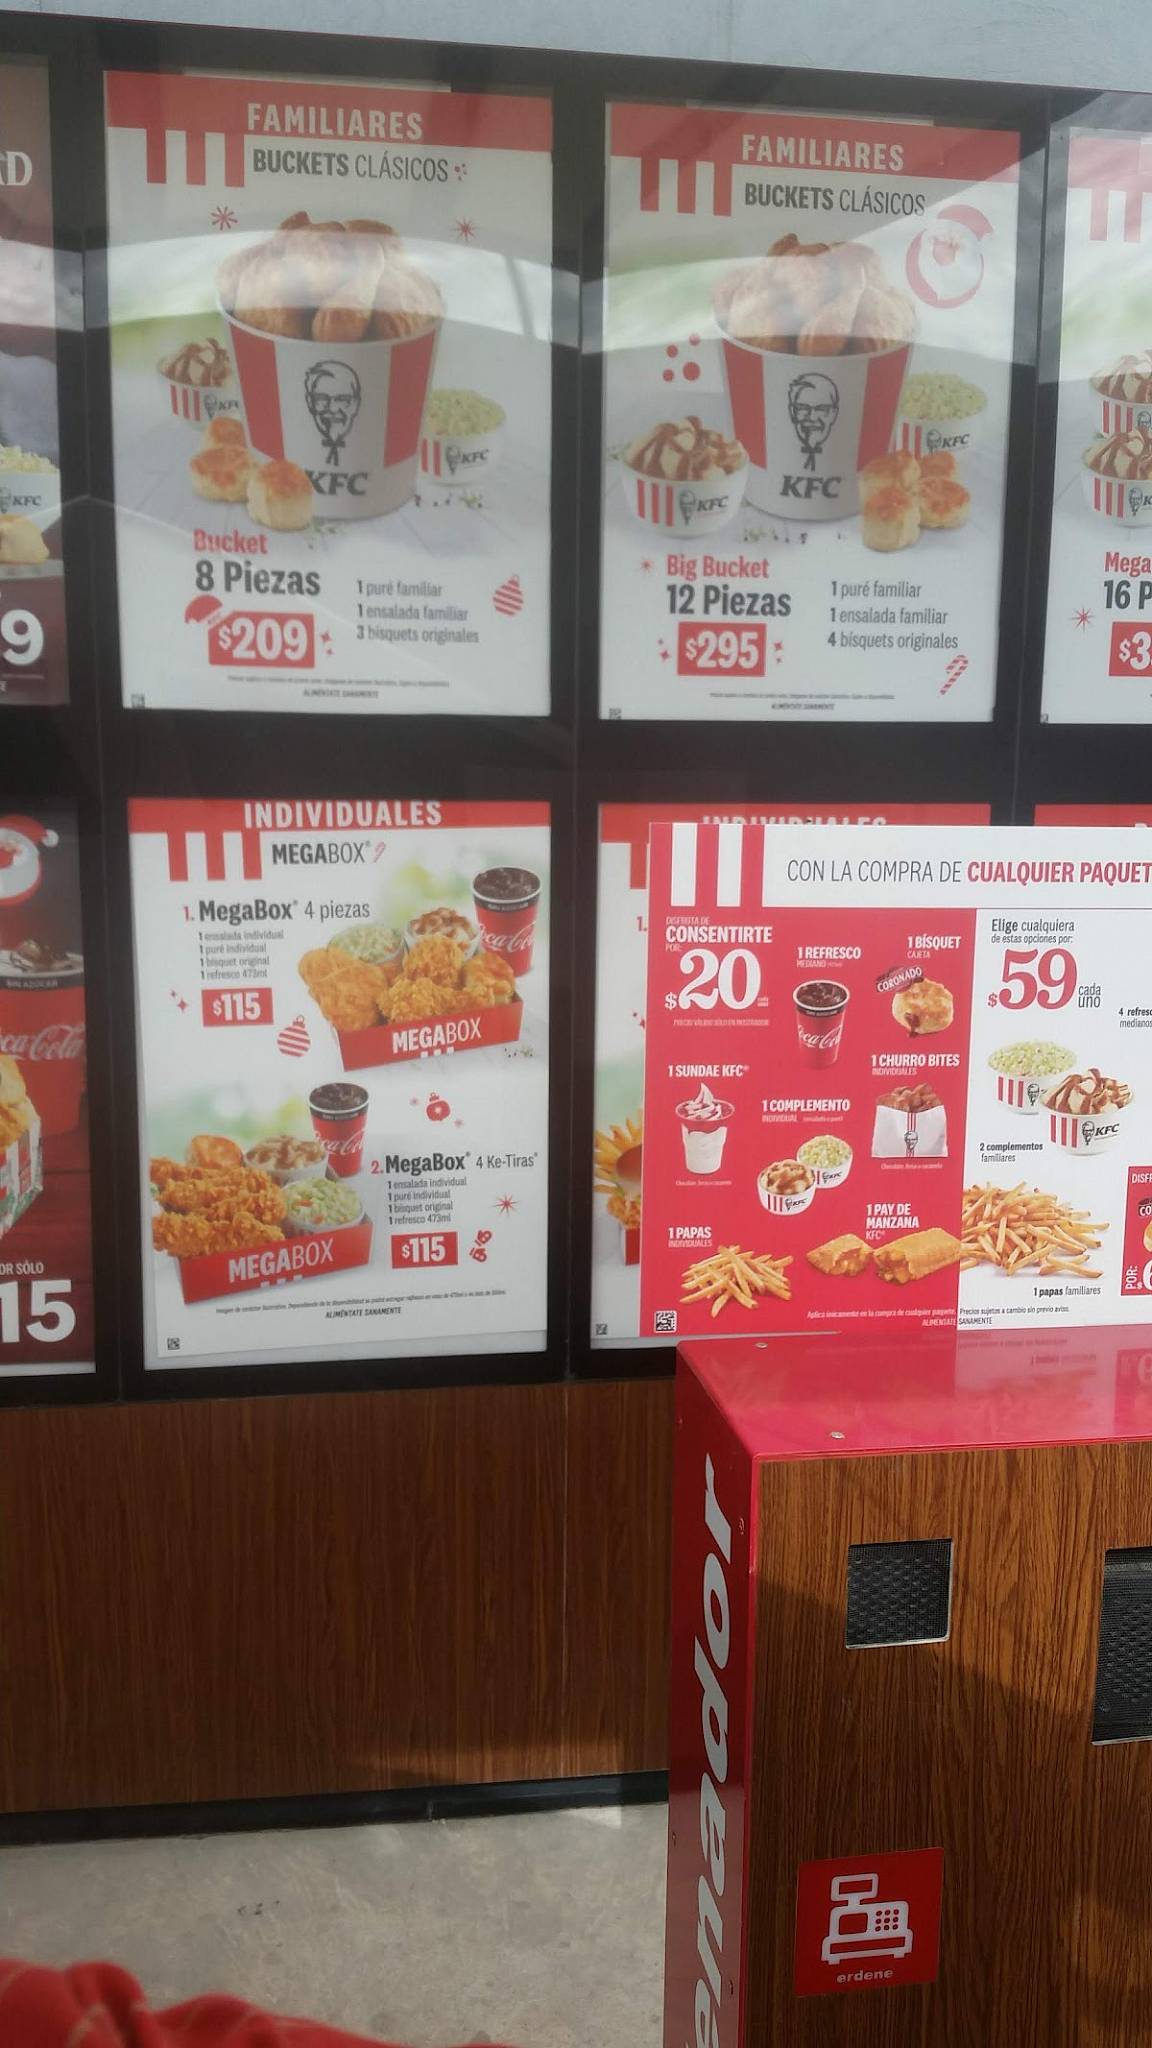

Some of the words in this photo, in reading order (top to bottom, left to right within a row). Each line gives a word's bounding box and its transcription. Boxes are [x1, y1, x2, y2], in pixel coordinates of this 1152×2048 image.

[247, 102, 423, 140] FAMILIARES
[742, 133, 905, 172] FAMILIARES
[252, 148, 350, 177] BUCKETS
[354, 150, 449, 182] CLÁSICOS
[744, 182, 835, 211] BUCKETS
[839, 185, 926, 217] CLÁSICOS
[942, 433, 970, 449] KFC
[461, 449, 489, 464] KFC
[305, 469, 368, 496] KFC
[780, 475, 842, 499] KFC
[13, 495, 41, 506] KFC
[697, 495, 729, 512] KFC
[193, 529, 268, 554] Bucket
[667, 554, 698, 582] Big
[703, 554, 770, 579] Bucket
[1104, 552, 1152, 577] Mega
[195, 560, 214, 592] 8
[224, 560, 321, 597] Piezas
[357, 579, 363, 594] 1
[396, 580, 442, 597] familiar
[831, 581, 838, 597] 1
[840, 580, 869, 600] puré
[872, 581, 921, 599] familiar
[1104, 580, 1131, 609] 16
[667, 584, 694, 614] 12
[704, 584, 791, 618] Piezas
[357, 602, 363, 618] 1
[366, 603, 420, 620] ensalada
[423, 604, 468, 621] familiar
[830, 607, 836, 623] 1
[839, 607, 896, 624] ensalada
[899, 607, 947, 625] familiar
[219, 616, 308, 661] $209
[356, 625, 364, 640] 3
[422, 627, 479, 645] originales
[827, 632, 837, 648] 4
[896, 632, 958, 652] originales
[685, 629, 759, 669] $295
[1119, 631, 1152, 671] $3
[244, 801, 442, 829] INDIVIDUALES
[787, 859, 826, 883] CON
[831, 859, 852, 882] LA
[858, 860, 933, 883] COMPRA
[940, 860, 962, 883] DE
[967, 861, 1075, 887] CUALQUIER
[1080, 861, 1152, 887] PAQUET
[304, 903, 316, 919] 4
[320, 900, 370, 922] piezas
[244, 929, 284, 940] individual
[665, 926, 773, 943] CONSENTIRTE
[991, 918, 1019, 935] Elige
[1021, 919, 1075, 935] cualquiera
[907, 936, 913, 948] 1
[915, 933, 961, 950] BÍSQUET
[991, 934, 1001, 943] de
[1002, 935, 1022, 943] estas
[1023, 934, 1057, 944] opciones
[1058, 935, 1074, 944] por:
[226, 943, 267, 954] individual
[798, 946, 803, 959] 1
[805, 946, 862, 959] REFRESCO
[907, 950, 931, 959] CAJETA
[239, 956, 269, 968] original
[797, 960, 827, 968] MEDIANO
[664, 948, 761, 1010] $20
[877, 966, 922, 993] CORONADO
[988, 948, 1078, 1010] $59
[1078, 983, 1101, 996] cada
[213, 992, 261, 1022] $115
[1078, 996, 1101, 1008] uno
[1118, 1007, 1124, 1017] 4
[392, 1017, 482, 1055] MEGABOX
[871, 1055, 877, 1067] 1
[879, 1054, 926, 1067] CHURRO
[928, 1053, 960, 1067] BITES
[668, 1065, 673, 1077] 1
[675, 1064, 720, 1078] SUNDAE
[769, 1099, 850, 1113] COMPLEMENTO
[1095, 1123, 1120, 1137] KFC
[979, 1143, 985, 1152] 2
[986, 1142, 1044, 1152] complementos
[371, 1160, 384, 1175] 2.
[475, 1155, 483, 1169] 4
[981, 1153, 1016, 1163] familiares
[393, 1179, 428, 1190] ensalada
[430, 1176, 467, 1188] individual
[413, 1189, 450, 1200] individual
[425, 1201, 453, 1212] original
[867, 1203, 872, 1216] 1
[874, 1203, 895, 1216] PAY
[897, 1203, 911, 1216] DE
[394, 1214, 426, 1225] refresco
[866, 1216, 919, 1229] MANZANA
[668, 1228, 674, 1239] 1
[676, 1226, 712, 1239] PAPAS
[401, 1236, 446, 1263] $115
[668, 1239, 713, 1248] INDIVIDUALES
[228, 1237, 335, 1284] MEGABOX
[1039, 1288, 1063, 1298] papas
[1065, 1285, 1101, 1297] familiares
[0, 1279, 76, 1343] 15
[959, 1307, 979, 1315] Precios
[981, 1307, 1000, 1316] sujetos
[1006, 1306, 1026, 1314] cambio
[1036, 1306, 1054, 1314] previo
[958, 1316, 992, 1326] SANAMENTE
[690, 1452, 732, 2048] enador
[837, 1969, 894, 1983] erdene
